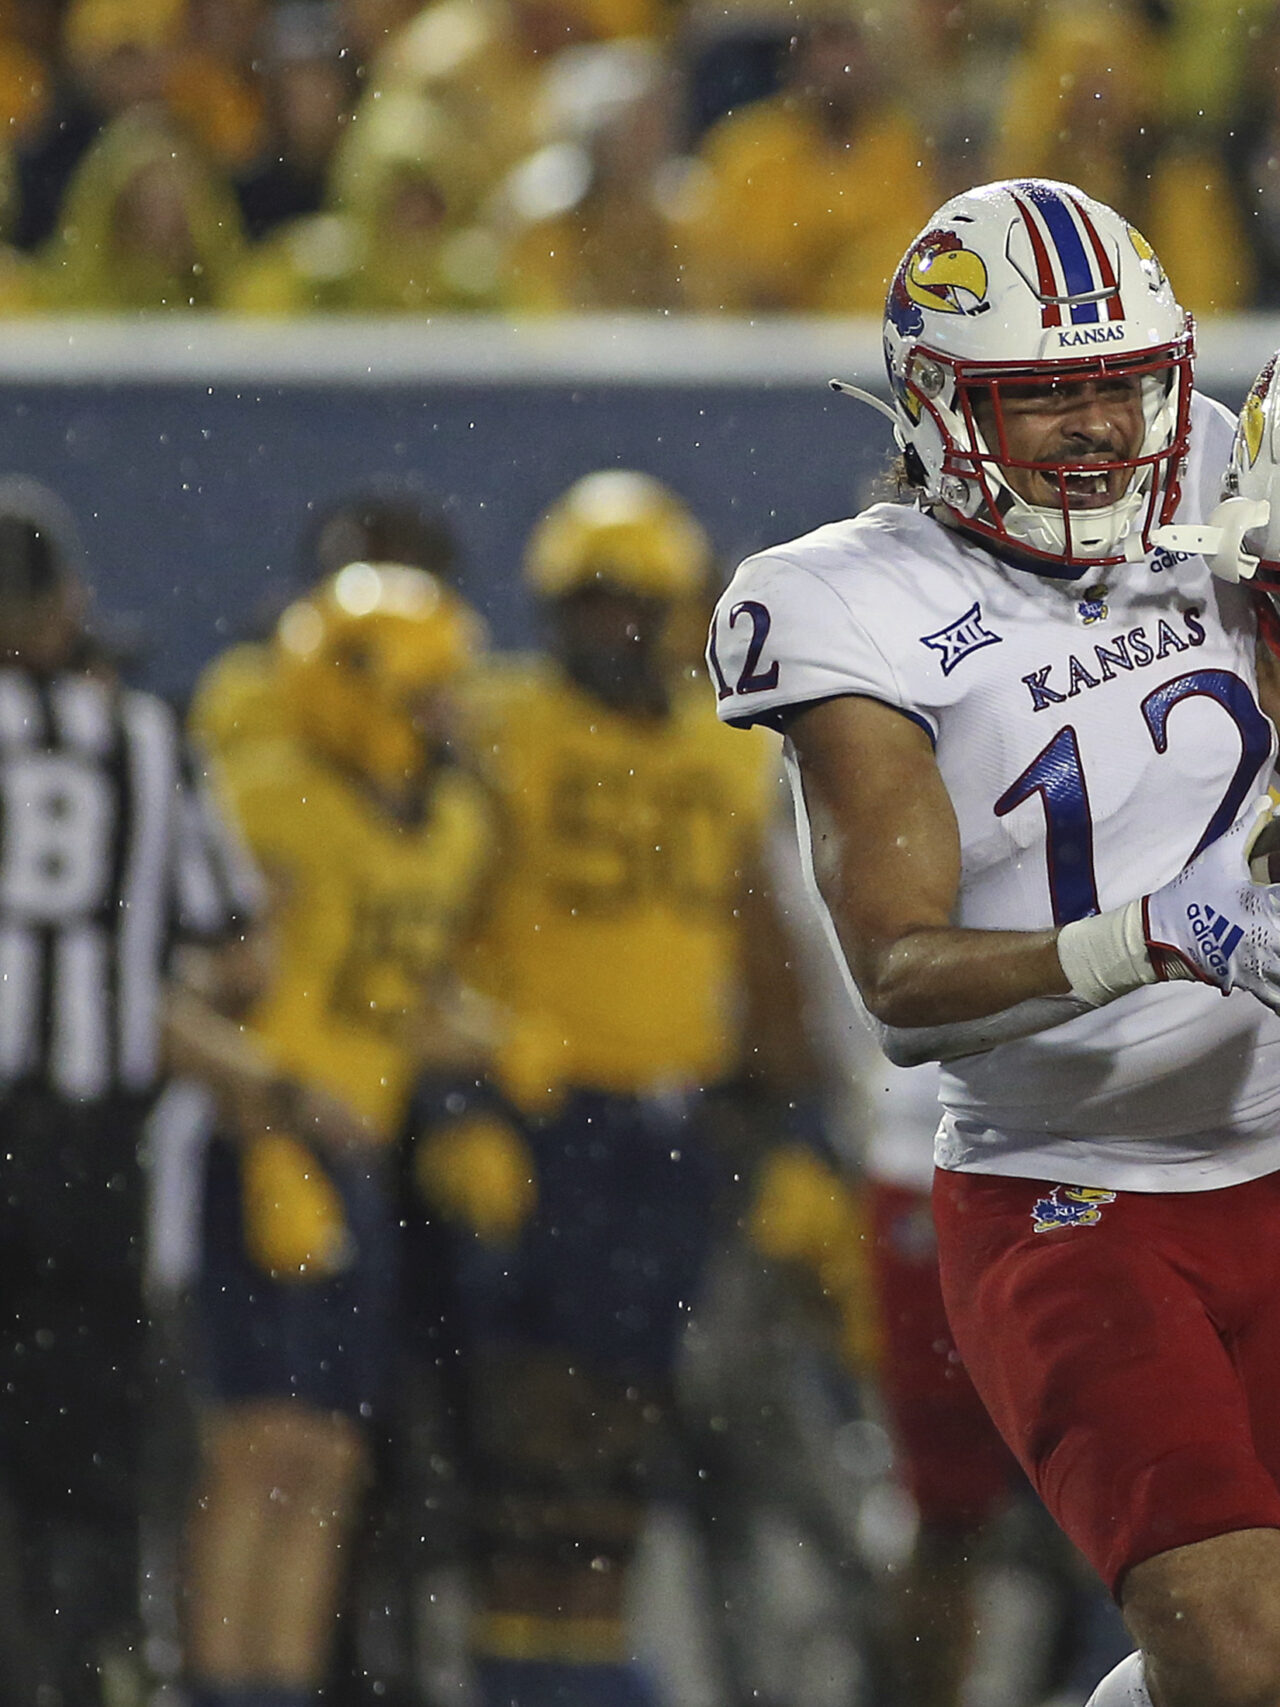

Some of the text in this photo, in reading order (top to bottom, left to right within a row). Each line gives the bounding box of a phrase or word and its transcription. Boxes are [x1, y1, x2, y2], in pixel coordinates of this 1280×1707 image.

[1058, 324, 1125, 347] KANSAS
[709, 600, 779, 701] 12
[1022, 606, 1206, 712] KANSAS
[993, 668, 1271, 928] 12
[1186, 903, 1229, 977] adidas
